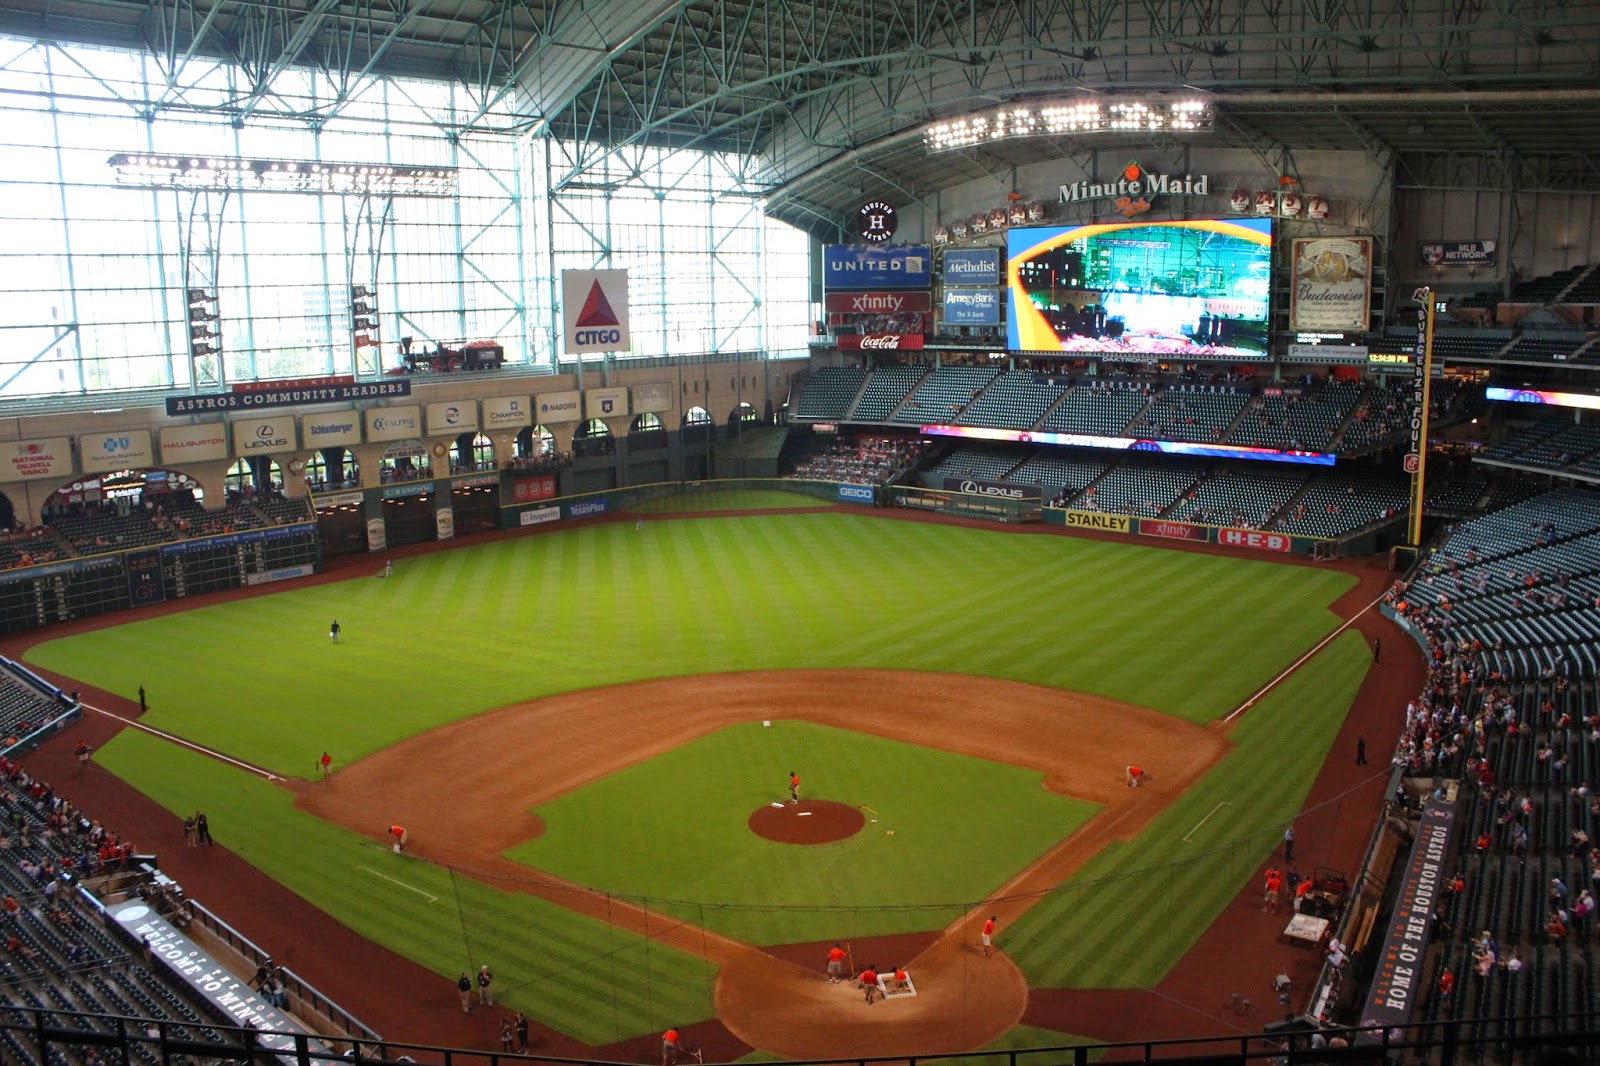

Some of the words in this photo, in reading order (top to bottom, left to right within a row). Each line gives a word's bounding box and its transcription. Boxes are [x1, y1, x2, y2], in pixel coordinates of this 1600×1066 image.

[1058, 179, 1141, 204] Minute
[1146, 174, 1209, 196] Maid
[1286, 193, 1297, 207] 5
[1312, 196, 1321, 210] 7
[861, 202, 893, 215] HOUSTON
[870, 215, 884, 229] H
[863, 230, 891, 241] ASTROS
[1459, 244, 1476, 252] MLB
[1446, 251, 1487, 259] NETWORK
[832, 260, 901, 271] UNITED
[948, 261, 996, 273] Methodist
[1297, 283, 1364, 301] Budweiser
[852, 293, 904, 311] xfinity
[575, 329, 620, 346] CITGO
[1102, 356, 1159, 364] DAKTRONICS
[1397, 355, 1409, 363] PM
[1092, 381, 1151, 389] HOUSTON
[1180, 385, 1235, 394] ASTROS
[177, 396, 236, 410] ASTROS
[244, 389, 336, 404] COMMUNITY
[343, 384, 403, 397] LEADERS
[550, 402, 577, 411] NABORS
[490, 411, 525, 420] CHAMPION
[310, 423, 353, 435] Schlumberger
[384, 418, 415, 428] CALPINE
[1411, 406, 1422, 453] FOUL
[163, 437, 225, 449] HALLIBURTON
[244, 438, 288, 449] LEXUS
[12, 454, 55, 464] NATIONAL
[17, 462, 52, 470] OILWELL
[21, 468, 49, 476] VARCO
[840, 488, 872, 498] GEICO
[979, 487, 1023, 498] LEXUS
[570, 502, 605, 516] TexanPlus
[530, 510, 559, 522] Insperity
[1067, 512, 1127, 531] STANLEY
[1156, 522, 1191, 538] xfinity
[1226, 531, 1283, 550] H-E-B
[1426, 825, 1448, 861] ASTROS
[1412, 862, 1439, 914] HOUSTON
[1405, 916, 1426, 941] THE
[1375, 945, 1399, 1005] WELCOME
[1393, 924, 1404, 938] TO
[1400, 879, 1417, 917] MINUTE
[134, 923, 203, 976] WELCOME
[195, 973, 222, 992] TO
[150, 919, 184, 946] HOME
[189, 951, 208, 963] OF
[212, 969, 239, 990] THE
[1399, 943, 1418, 962] OF
[1386, 966, 1413, 1010] HOME
